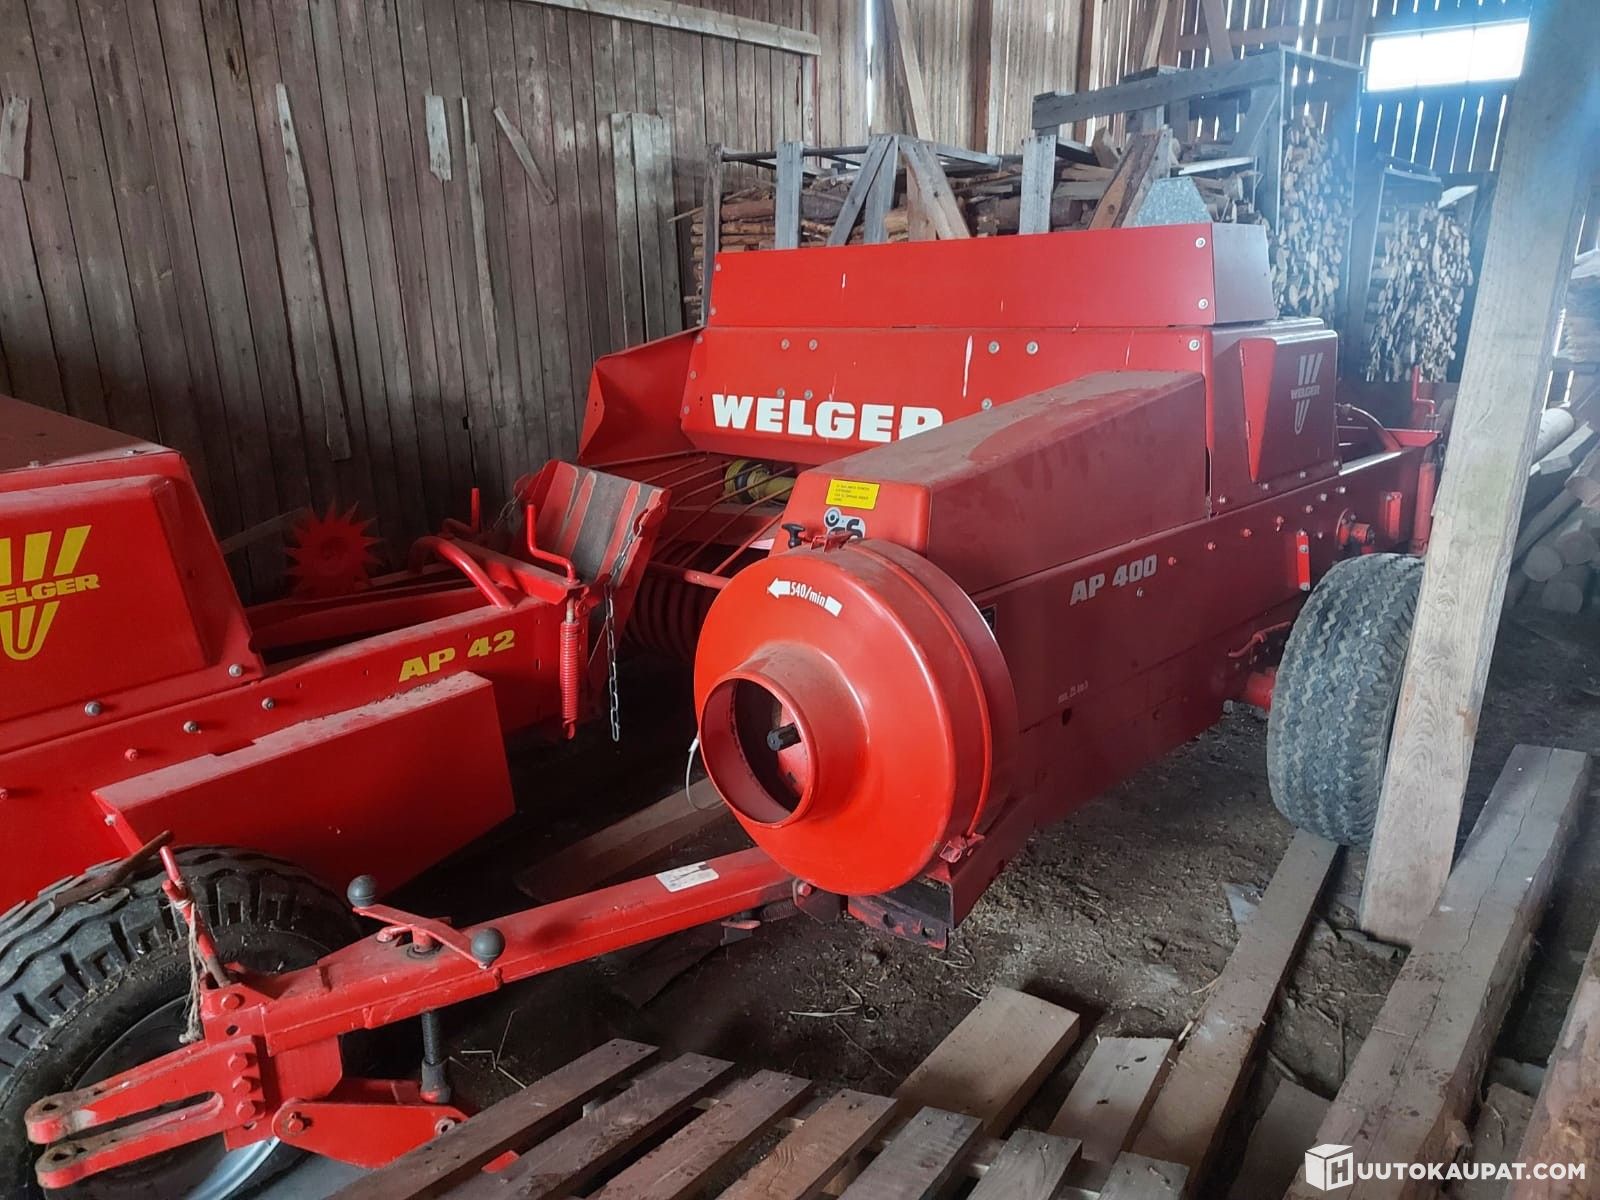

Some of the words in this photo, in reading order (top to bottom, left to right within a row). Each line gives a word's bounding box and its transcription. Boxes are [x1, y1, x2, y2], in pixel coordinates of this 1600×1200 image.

[711, 394, 944, 443] WELGER
[0, 574, 101, 608] ELGER
[790, 581, 826, 608] 540/min
[1070, 573, 1106, 606] AP
[1112, 554, 1157, 588] 400
[399, 647, 456, 682] AP
[467, 629, 515, 657] 42
